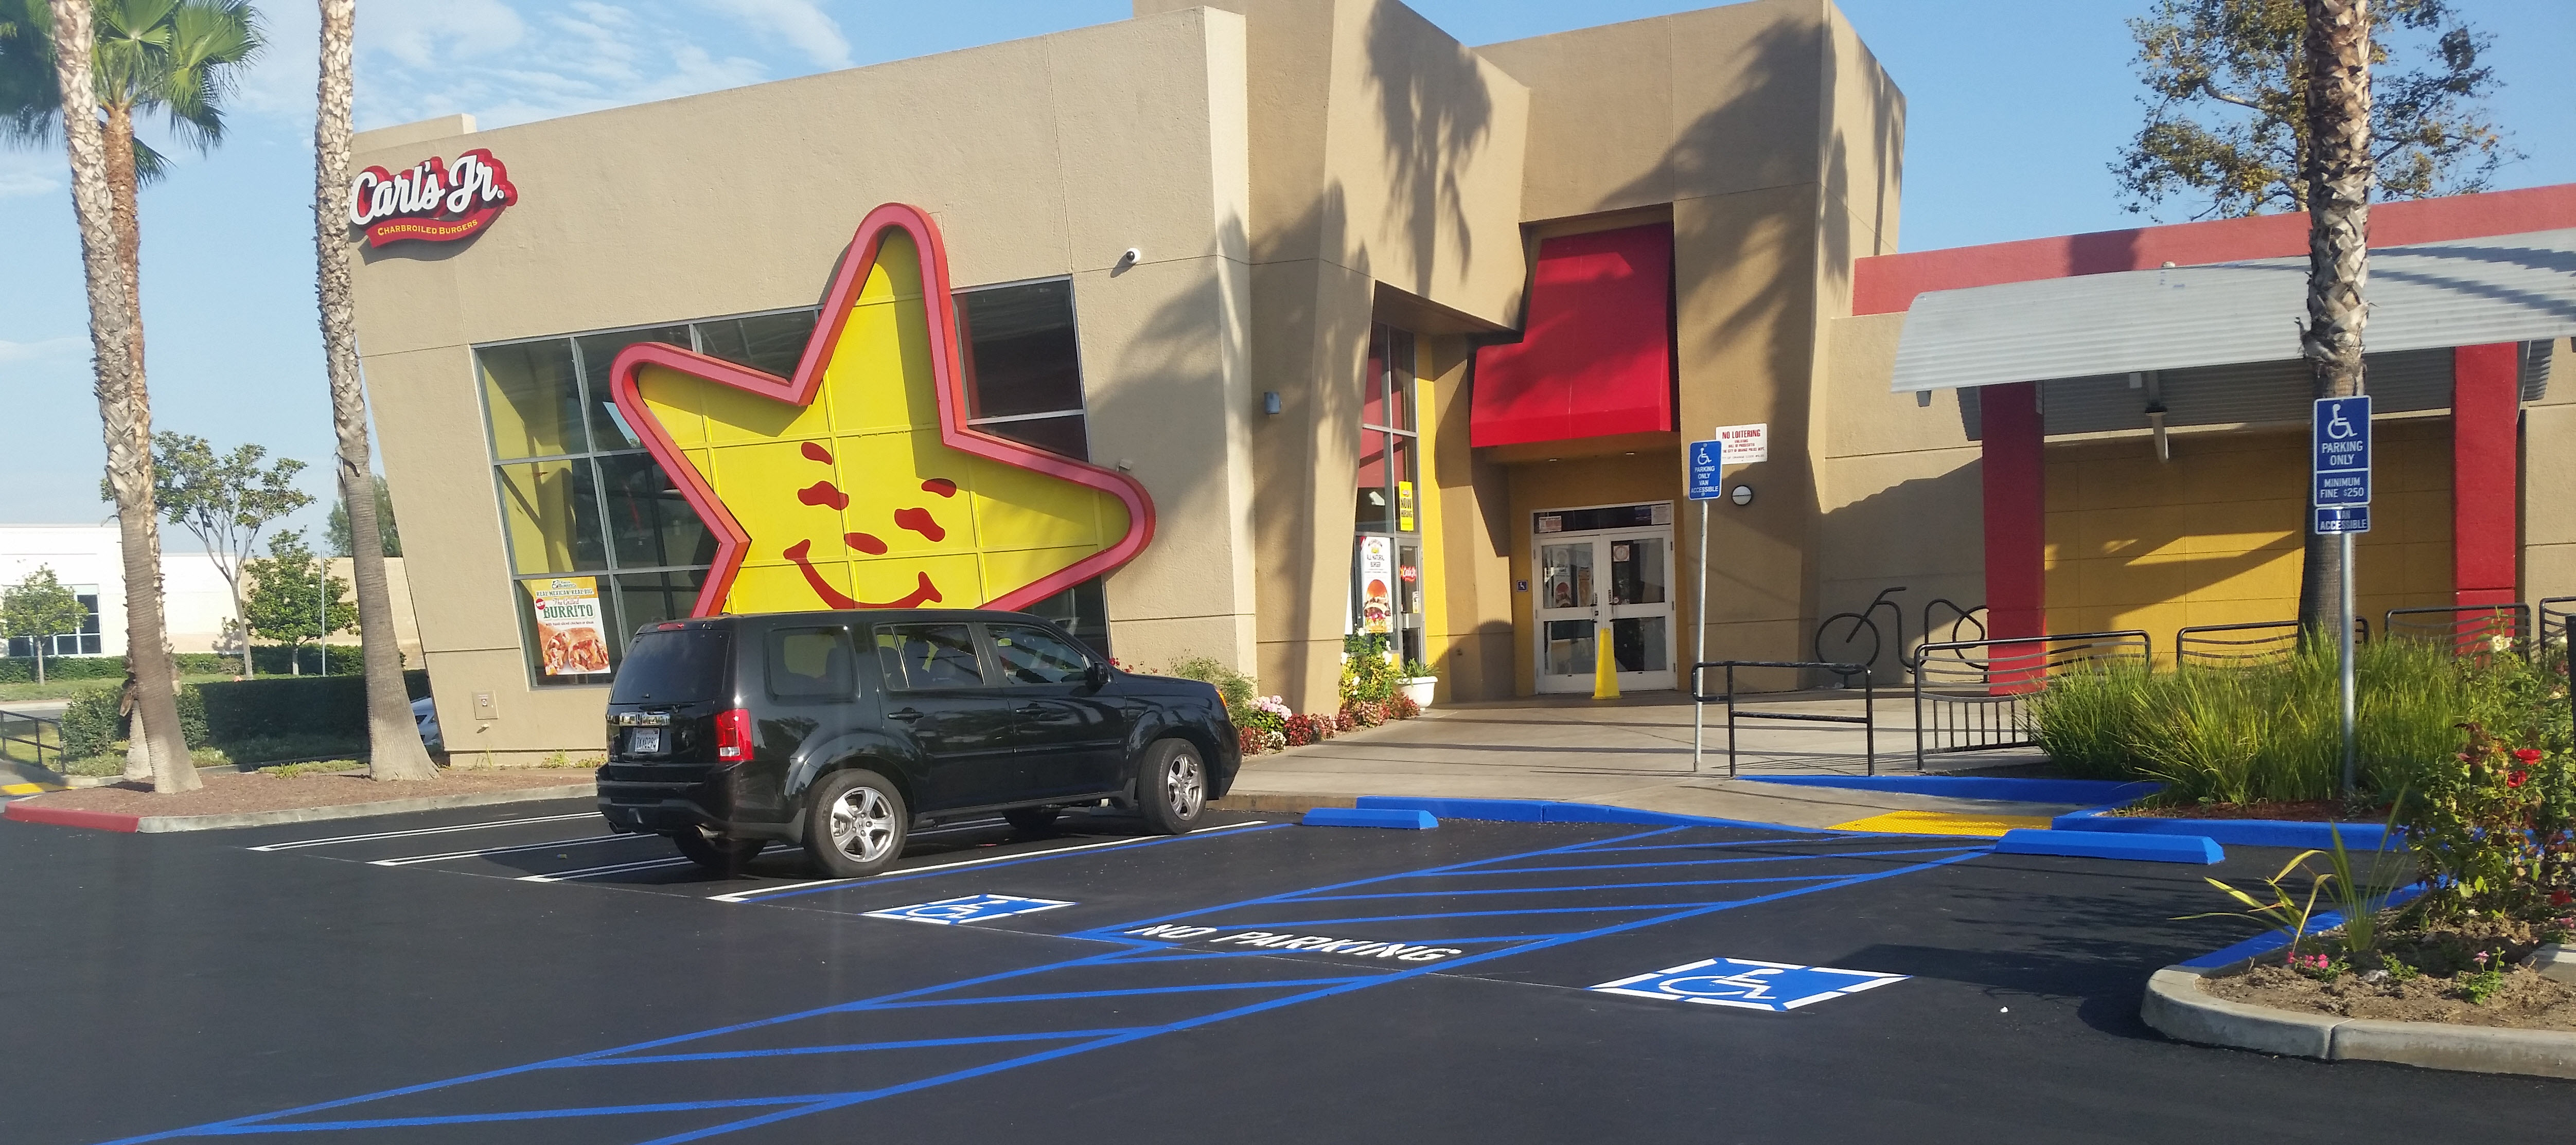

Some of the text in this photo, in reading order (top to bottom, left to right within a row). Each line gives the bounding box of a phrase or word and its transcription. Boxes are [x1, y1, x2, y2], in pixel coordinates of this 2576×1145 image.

[349, 155, 505, 225] Carl's Jr.
[377, 219, 478, 236] CHARBROILED BURGERS
[1732, 429, 1760, 438] LOITERING
[2322, 440, 2363, 453] PARKING
[2330, 454, 2355, 466] ONLY
[2324, 477, 2360, 487] MINIMUM
[2320, 487, 2364, 498] FINE $250
[1401, 498, 1411, 509] NOW
[2320, 519, 2368, 530] ACCESSIBLE
[563, 597, 579, 605] Grilled
[543, 604, 593, 619] BURRITO
[1124, 924, 1462, 961] NO PARKING
